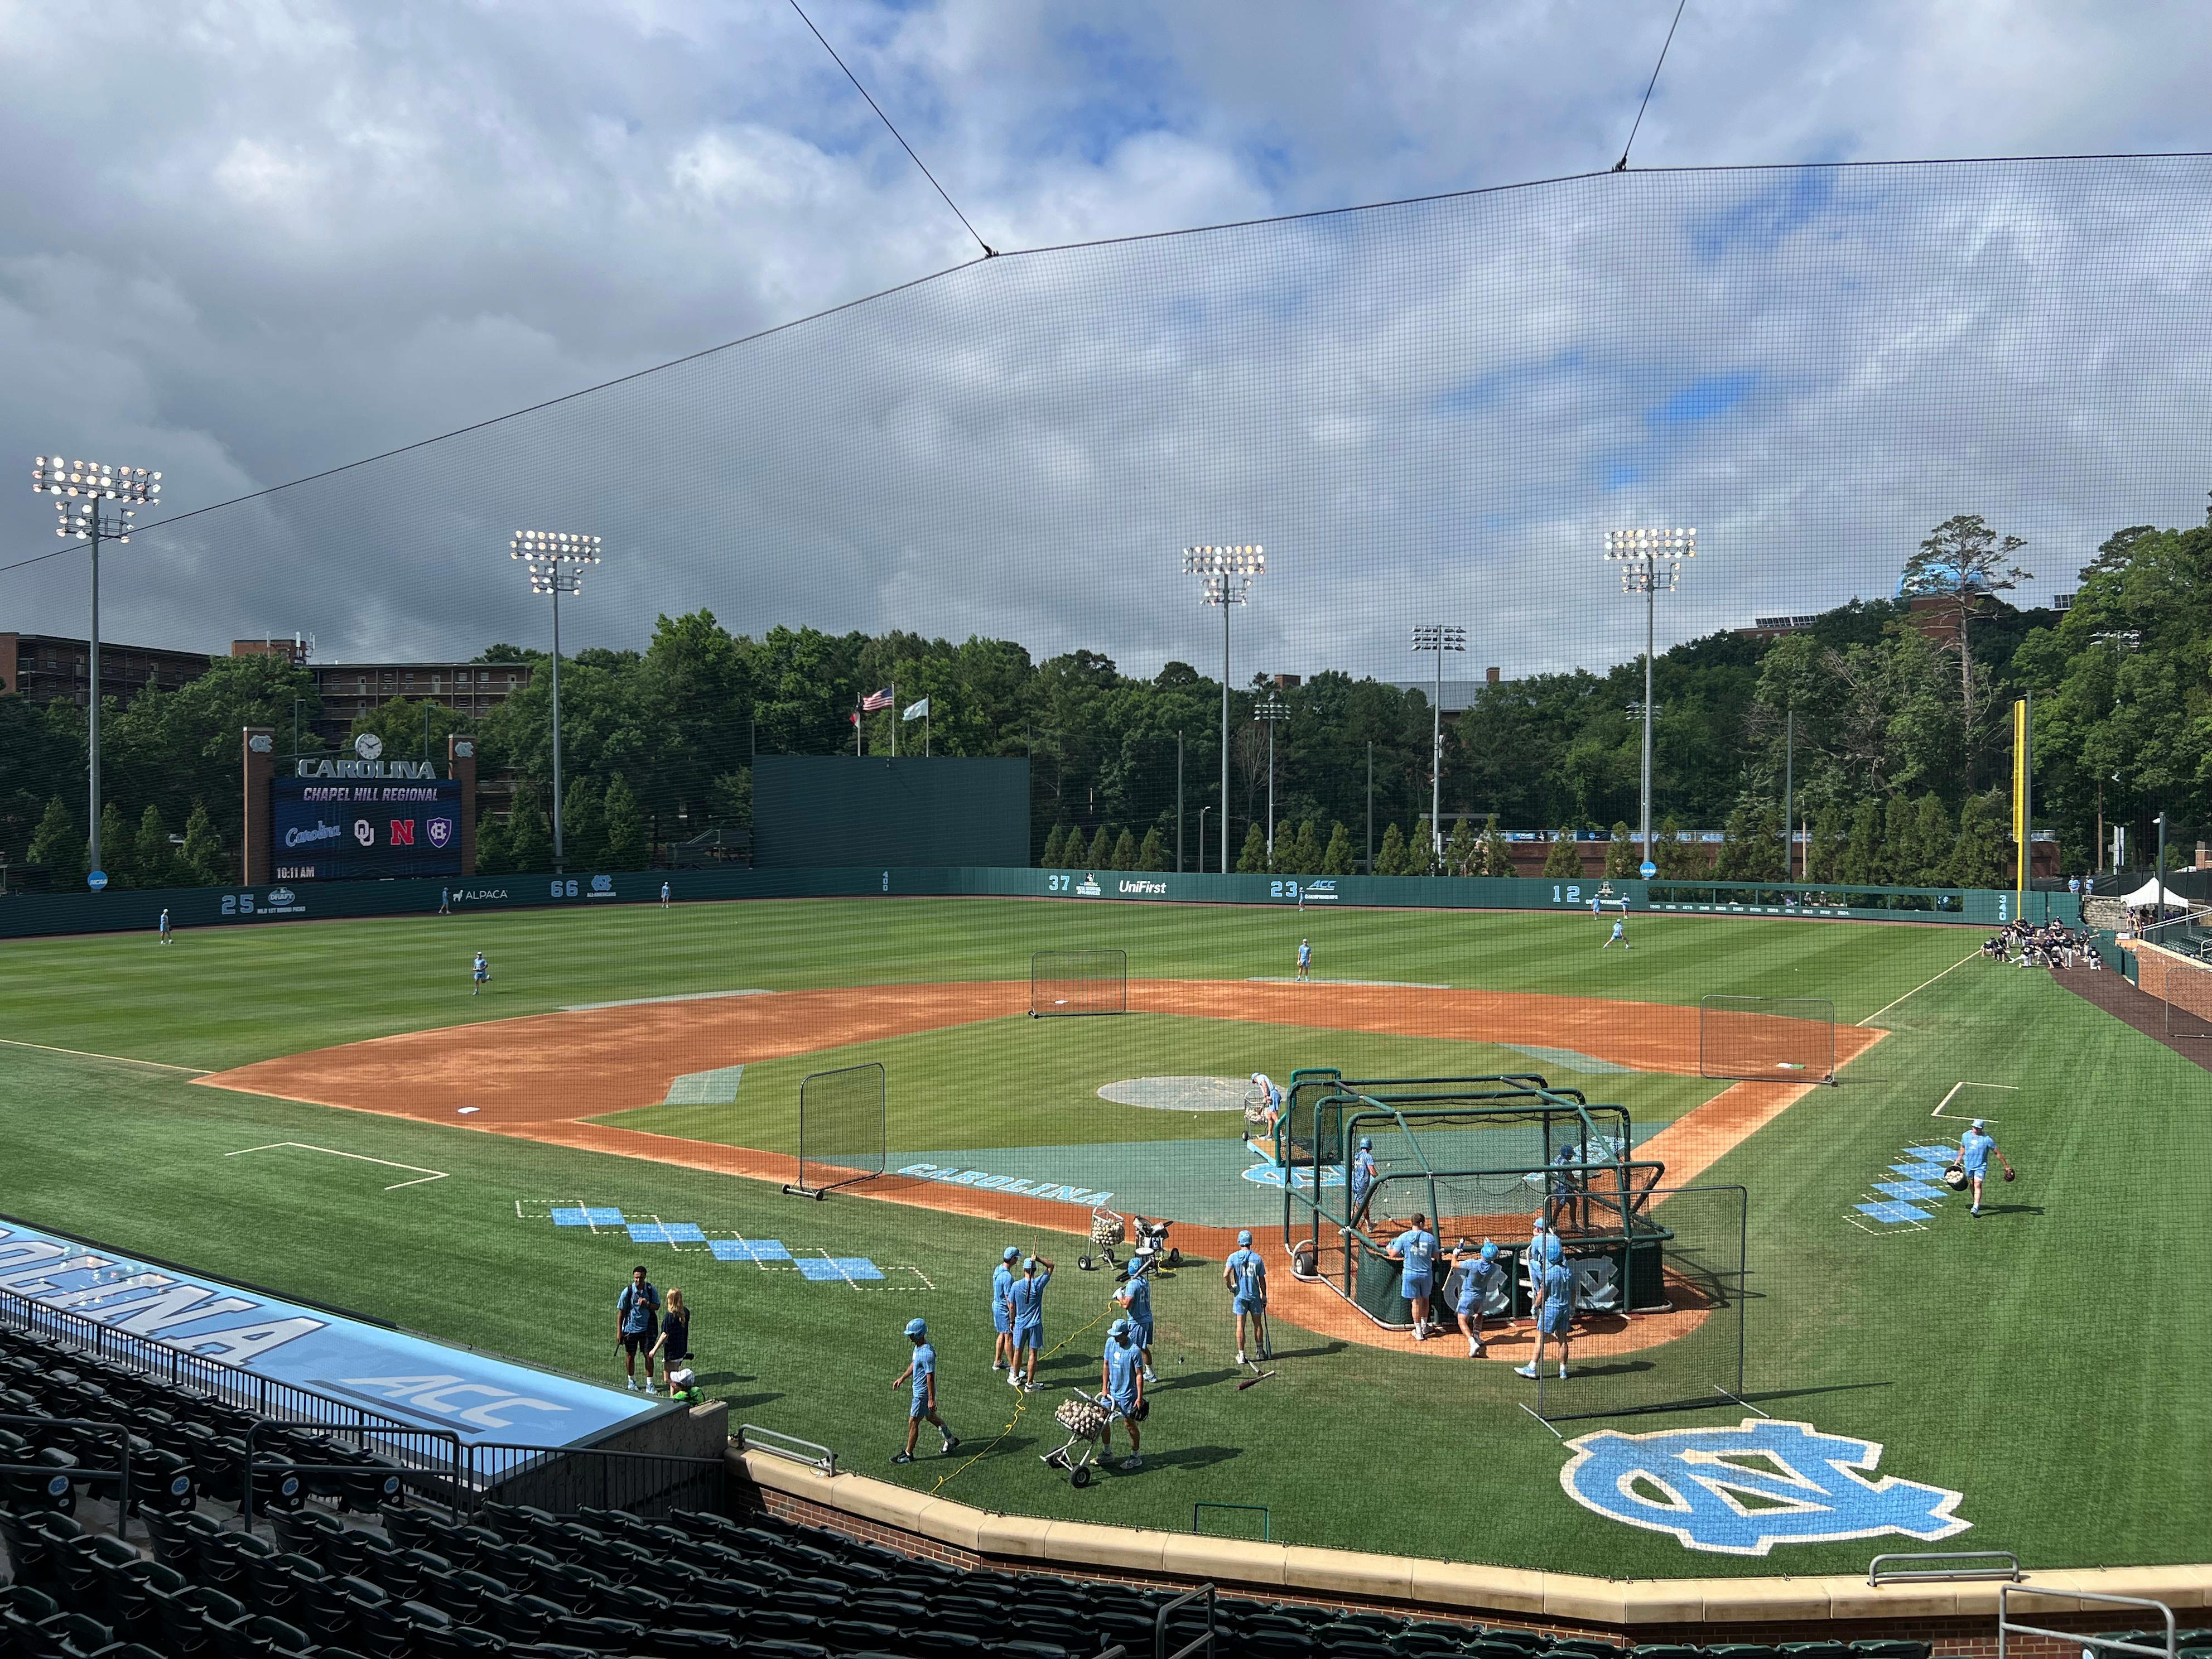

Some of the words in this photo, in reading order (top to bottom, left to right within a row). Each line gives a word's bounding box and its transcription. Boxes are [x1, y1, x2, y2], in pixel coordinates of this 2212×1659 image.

[298, 759, 436, 779] CAROLINA
[303, 787, 350, 802] CHAPEL
[353, 788, 379, 802] HILL
[382, 788, 438, 801] REGIONAL
[286, 820, 341, 847] Carolina
[354, 819, 374, 846] OU
[391, 819, 415, 845] N
[277, 867, 298, 879] 10:11
[300, 866, 315, 878] AM
[551, 880, 578, 897] 66
[1049, 875, 1070, 891] 37
[1119, 880, 1167, 894] UniFirst
[1271, 881, 1298, 897] 23
[465, 890, 508, 899] ALPACA
[1553, 885, 1580, 903] 12
[221, 894, 254, 914] 25
[898, 1164, 1114, 1205] CAROLINA
[1410, 1242, 1428, 1256] 45
[338, 1375, 574, 1428] ACC
